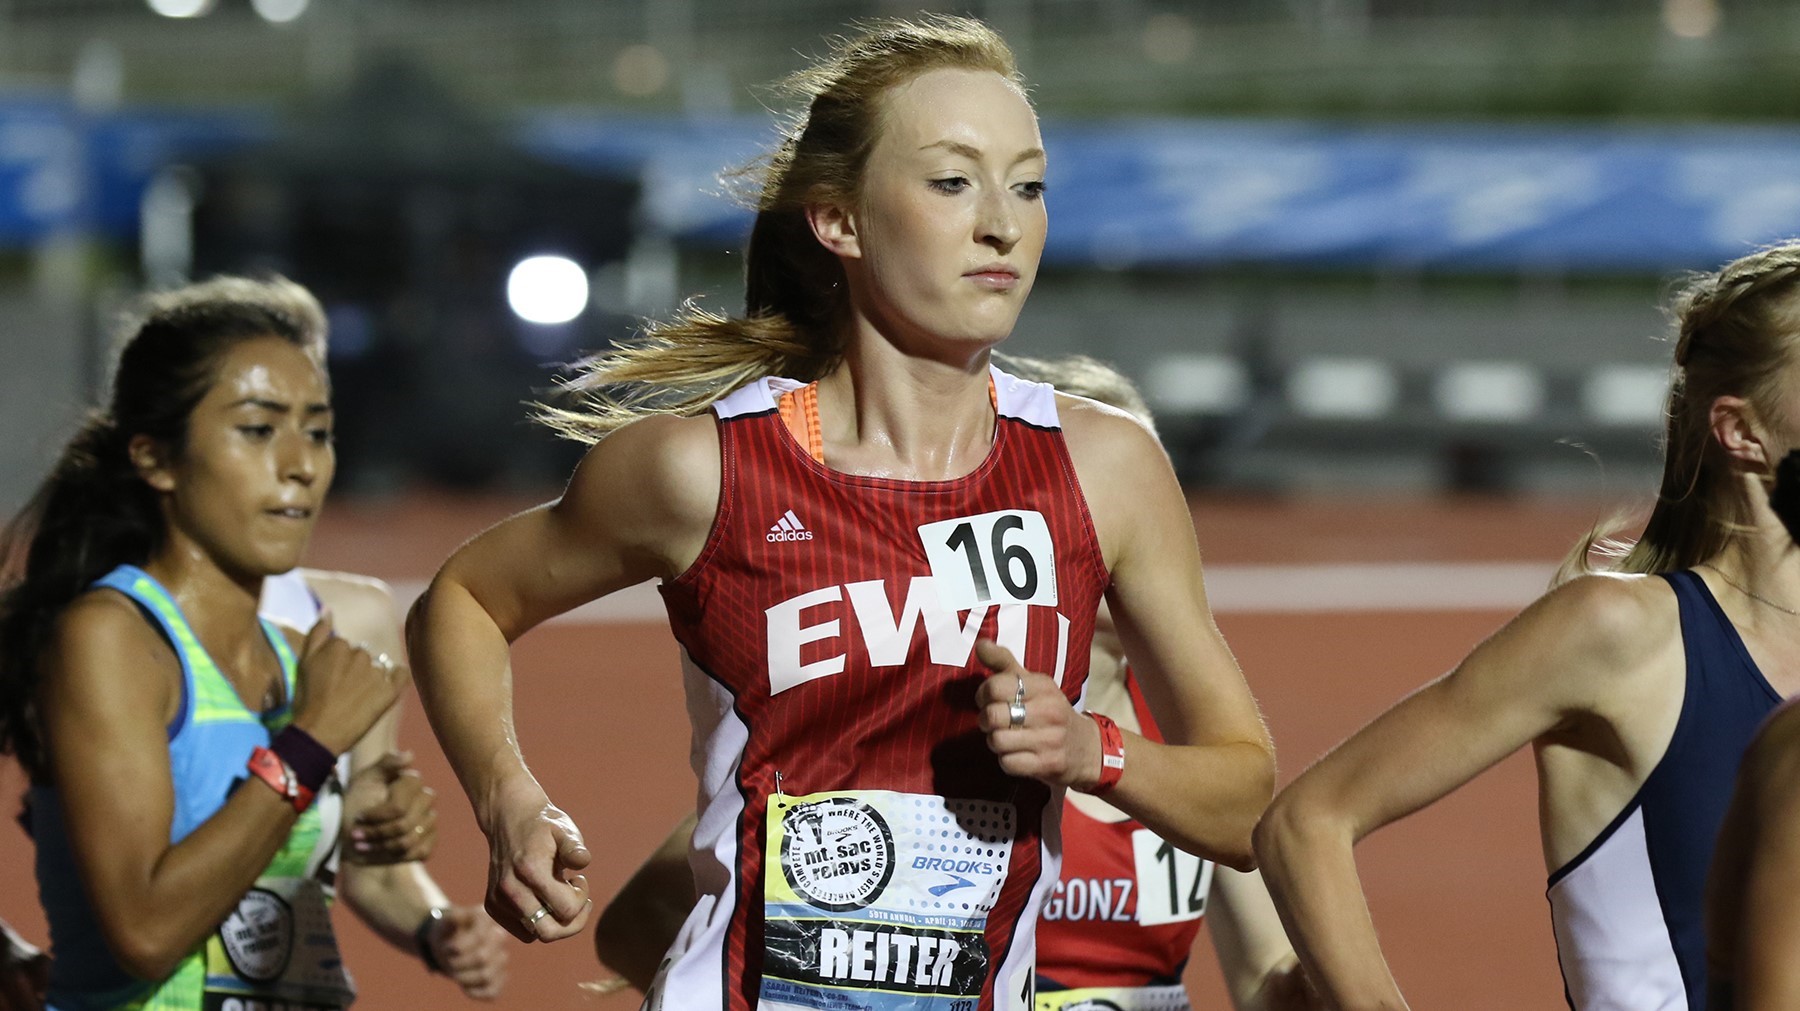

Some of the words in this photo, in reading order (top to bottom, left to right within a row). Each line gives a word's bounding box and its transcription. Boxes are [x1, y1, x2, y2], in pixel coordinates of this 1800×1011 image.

[766, 528, 813, 542] adidas
[945, 515, 1038, 601] 16
[861, 816, 876, 834] THE
[836, 840, 872, 859] sac
[792, 846, 811, 889] COMPETE
[811, 858, 872, 881] relays
[911, 855, 994, 875] BROOKS
[857, 878, 875, 896] BEST
[1042, 877, 1140, 922] GONZ
[868, 910, 888, 919] 59TH
[889, 913, 917, 925] ANNUAL
[924, 917, 946, 926] APRIL
[819, 928, 962, 987] REITER
